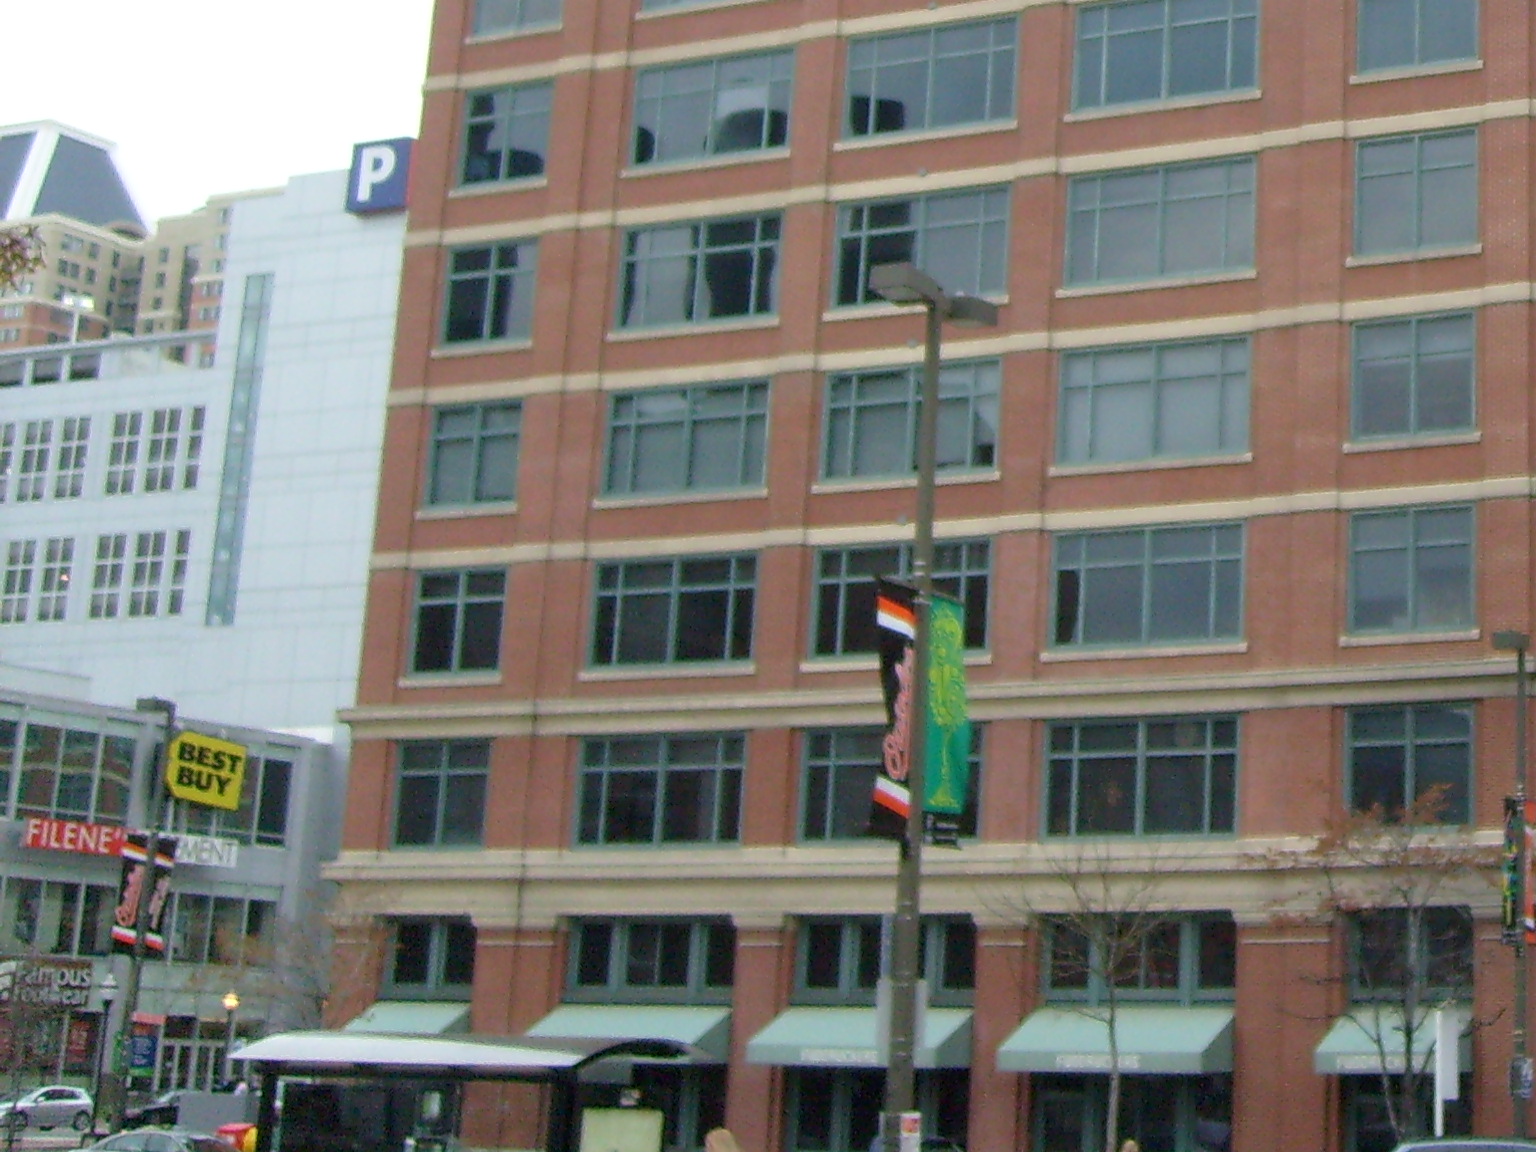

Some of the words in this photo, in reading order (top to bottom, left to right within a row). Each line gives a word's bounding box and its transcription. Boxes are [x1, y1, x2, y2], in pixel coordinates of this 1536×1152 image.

[356, 146, 396, 203] P
[179, 741, 242, 775] BEST
[177, 767, 232, 797] BUY
[25, 817, 128, 854] FILENE'
